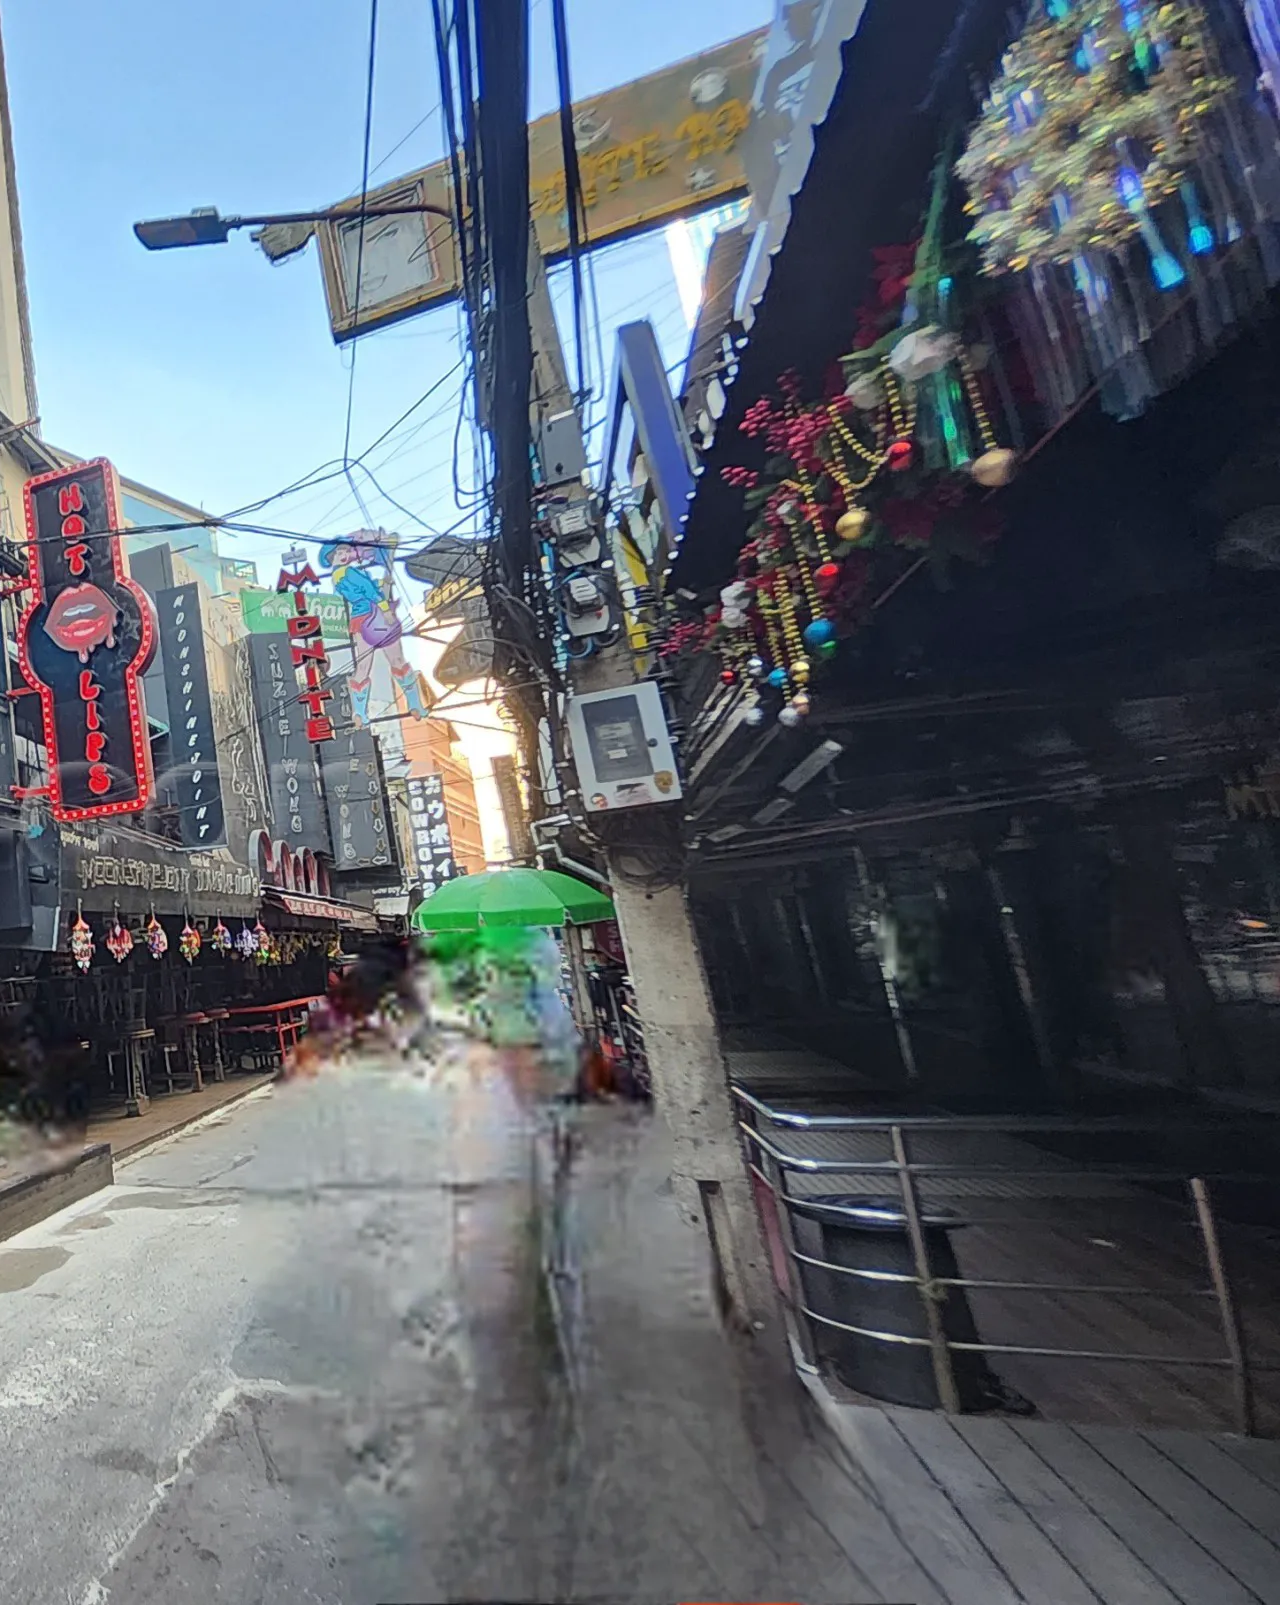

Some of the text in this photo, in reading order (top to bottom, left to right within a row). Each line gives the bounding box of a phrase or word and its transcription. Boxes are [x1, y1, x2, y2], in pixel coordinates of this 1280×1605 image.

[58, 482, 88, 575] HOT
[79, 669, 112, 794] LIPS
[276, 563, 334, 743] MIDNITE
[281, 758, 304, 833] WONG
[333, 784, 358, 859] WONG
[424, 776, 451, 887] カウボーイ
